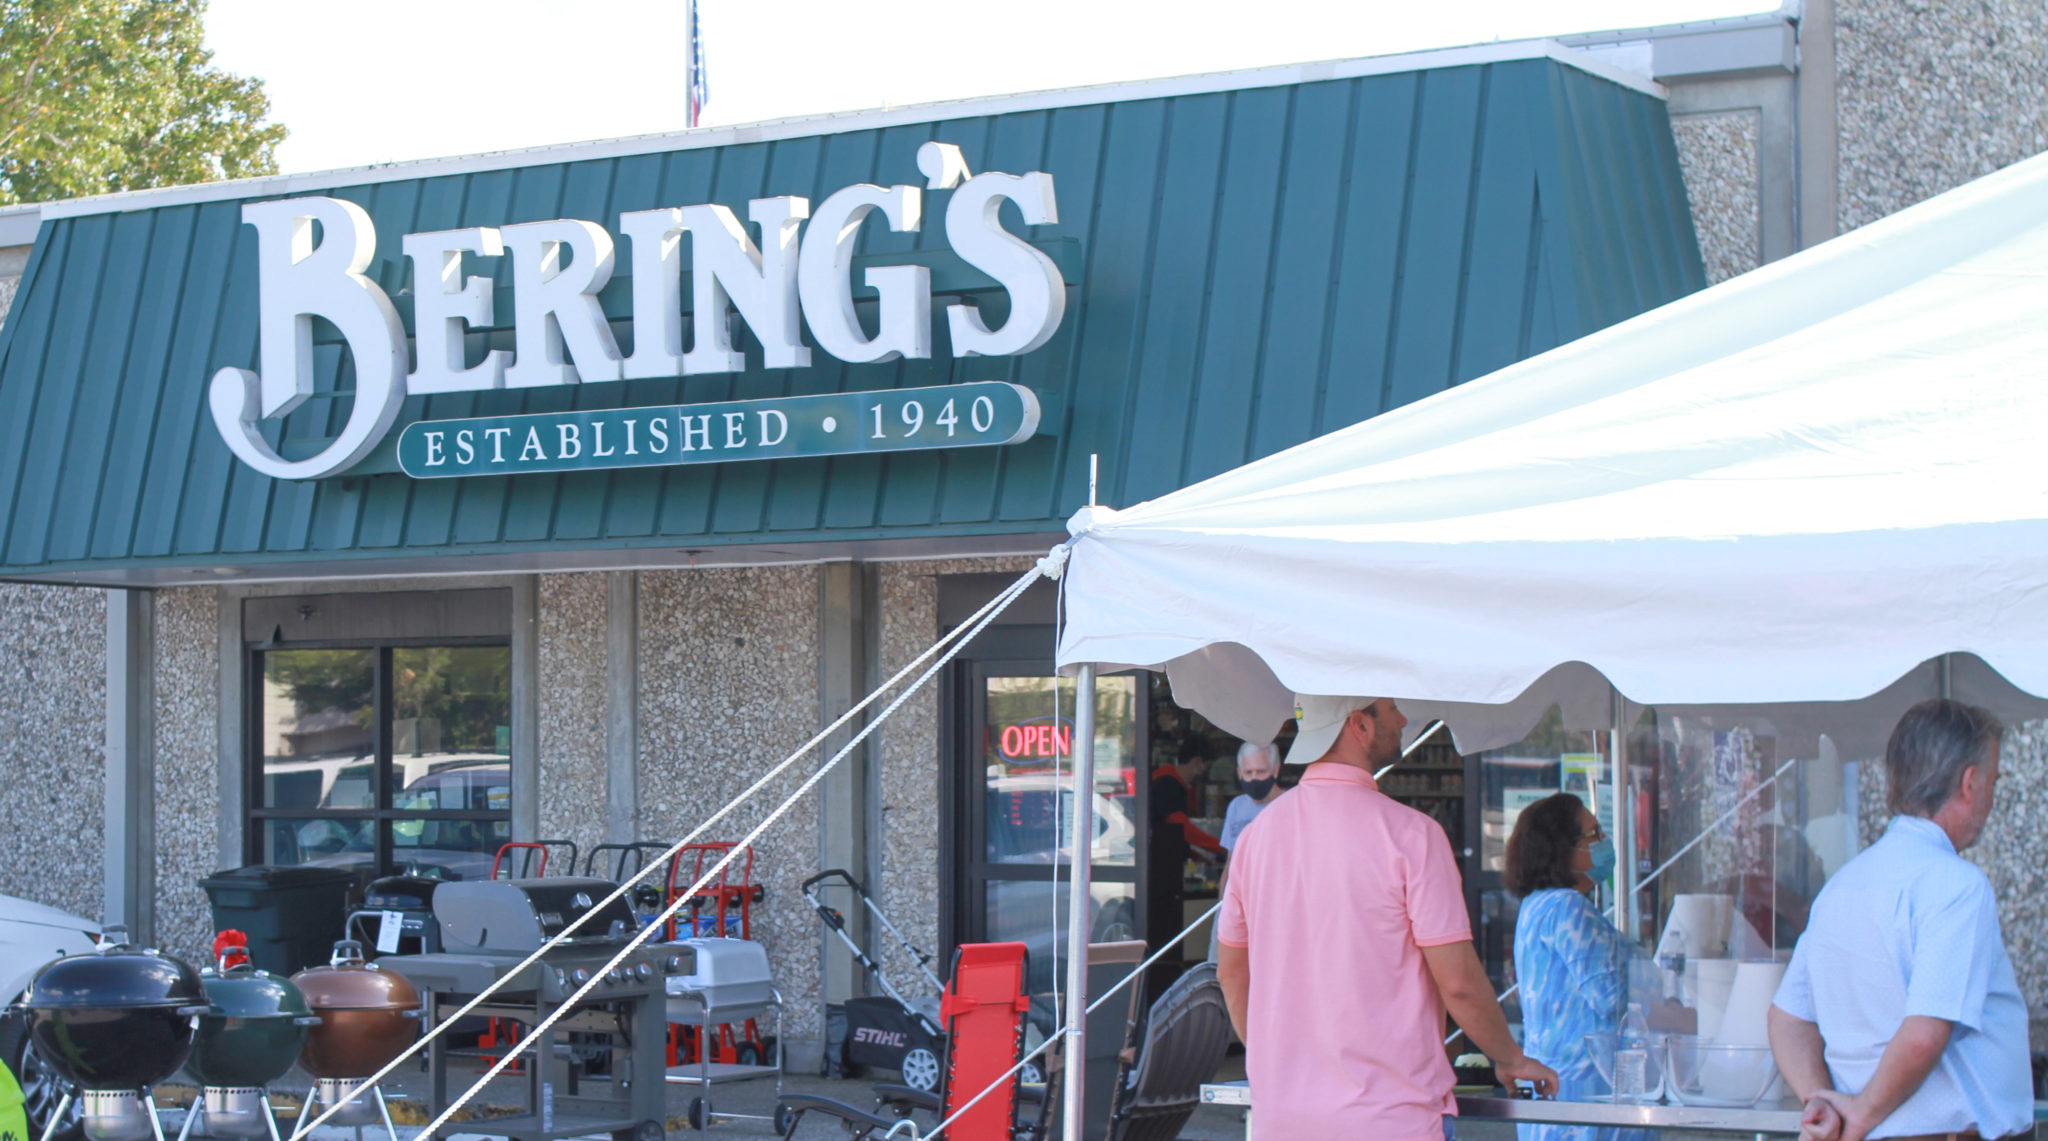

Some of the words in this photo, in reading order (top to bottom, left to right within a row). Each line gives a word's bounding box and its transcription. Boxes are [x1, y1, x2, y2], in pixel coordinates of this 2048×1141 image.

[208, 141, 1066, 480] BERING'S
[423, 409, 789, 467] ESTABLISHED
[870, 395, 995, 439] 1940
[1001, 725, 1071, 757] OPEN
[853, 1027, 905, 1048] STIHL
